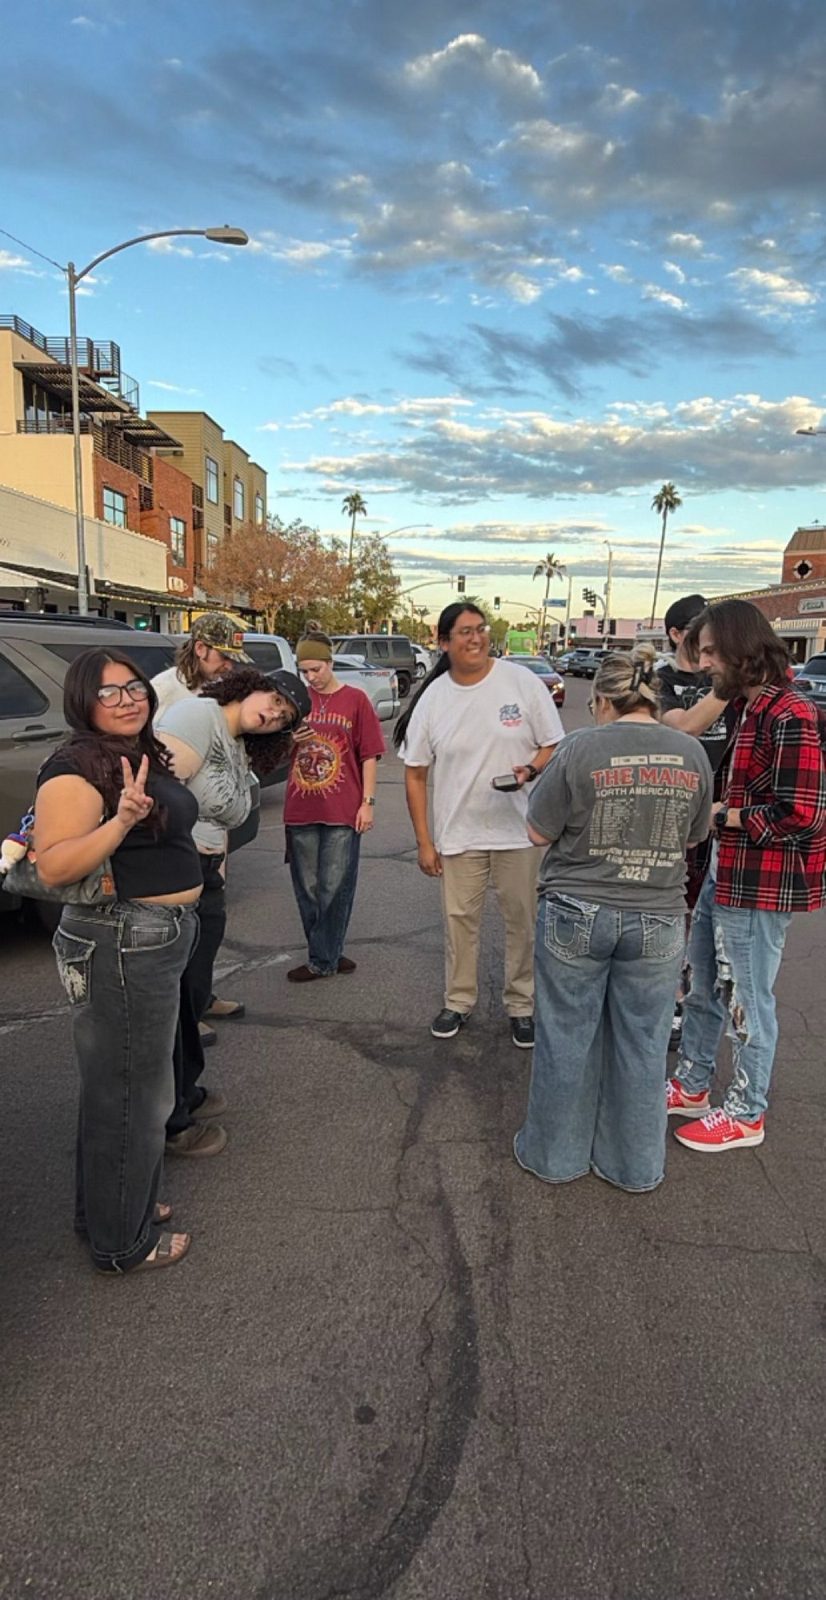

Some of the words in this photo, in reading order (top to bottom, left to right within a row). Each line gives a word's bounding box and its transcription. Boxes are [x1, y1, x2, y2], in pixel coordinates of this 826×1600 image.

[591, 767, 634, 788] THE
[639, 766, 700, 792] MAINE
[596, 787, 627, 798] NORTH
[629, 787, 675, 796] AMERICAN
